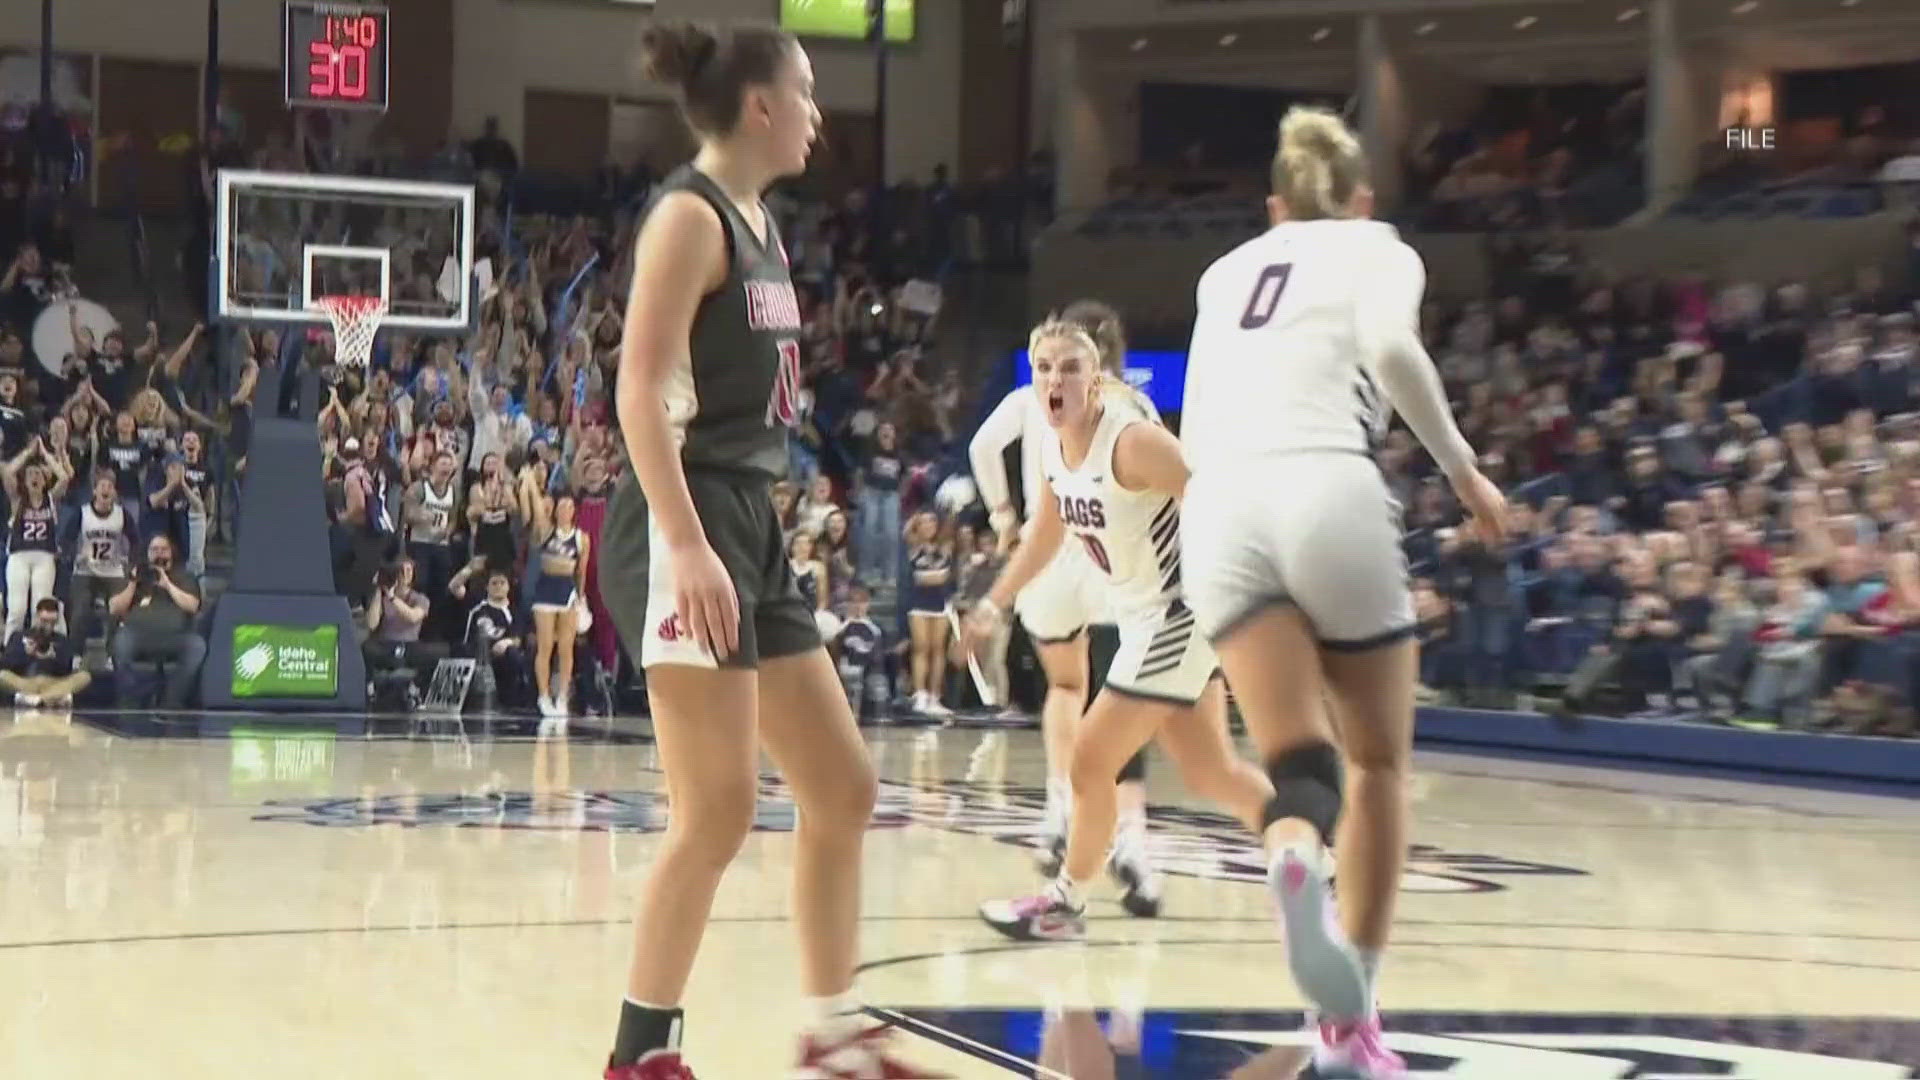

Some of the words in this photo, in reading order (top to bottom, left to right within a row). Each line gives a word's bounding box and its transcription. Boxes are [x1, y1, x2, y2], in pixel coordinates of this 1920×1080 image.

[326, 16, 376, 48] 1:40
[310, 42, 366, 97] 30
[1239, 262, 1292, 330] 0
[23, 521, 48, 541] 22
[92, 542, 111, 560] 12
[278, 646, 317, 660] Idaho
[278, 659, 330, 673] Central
